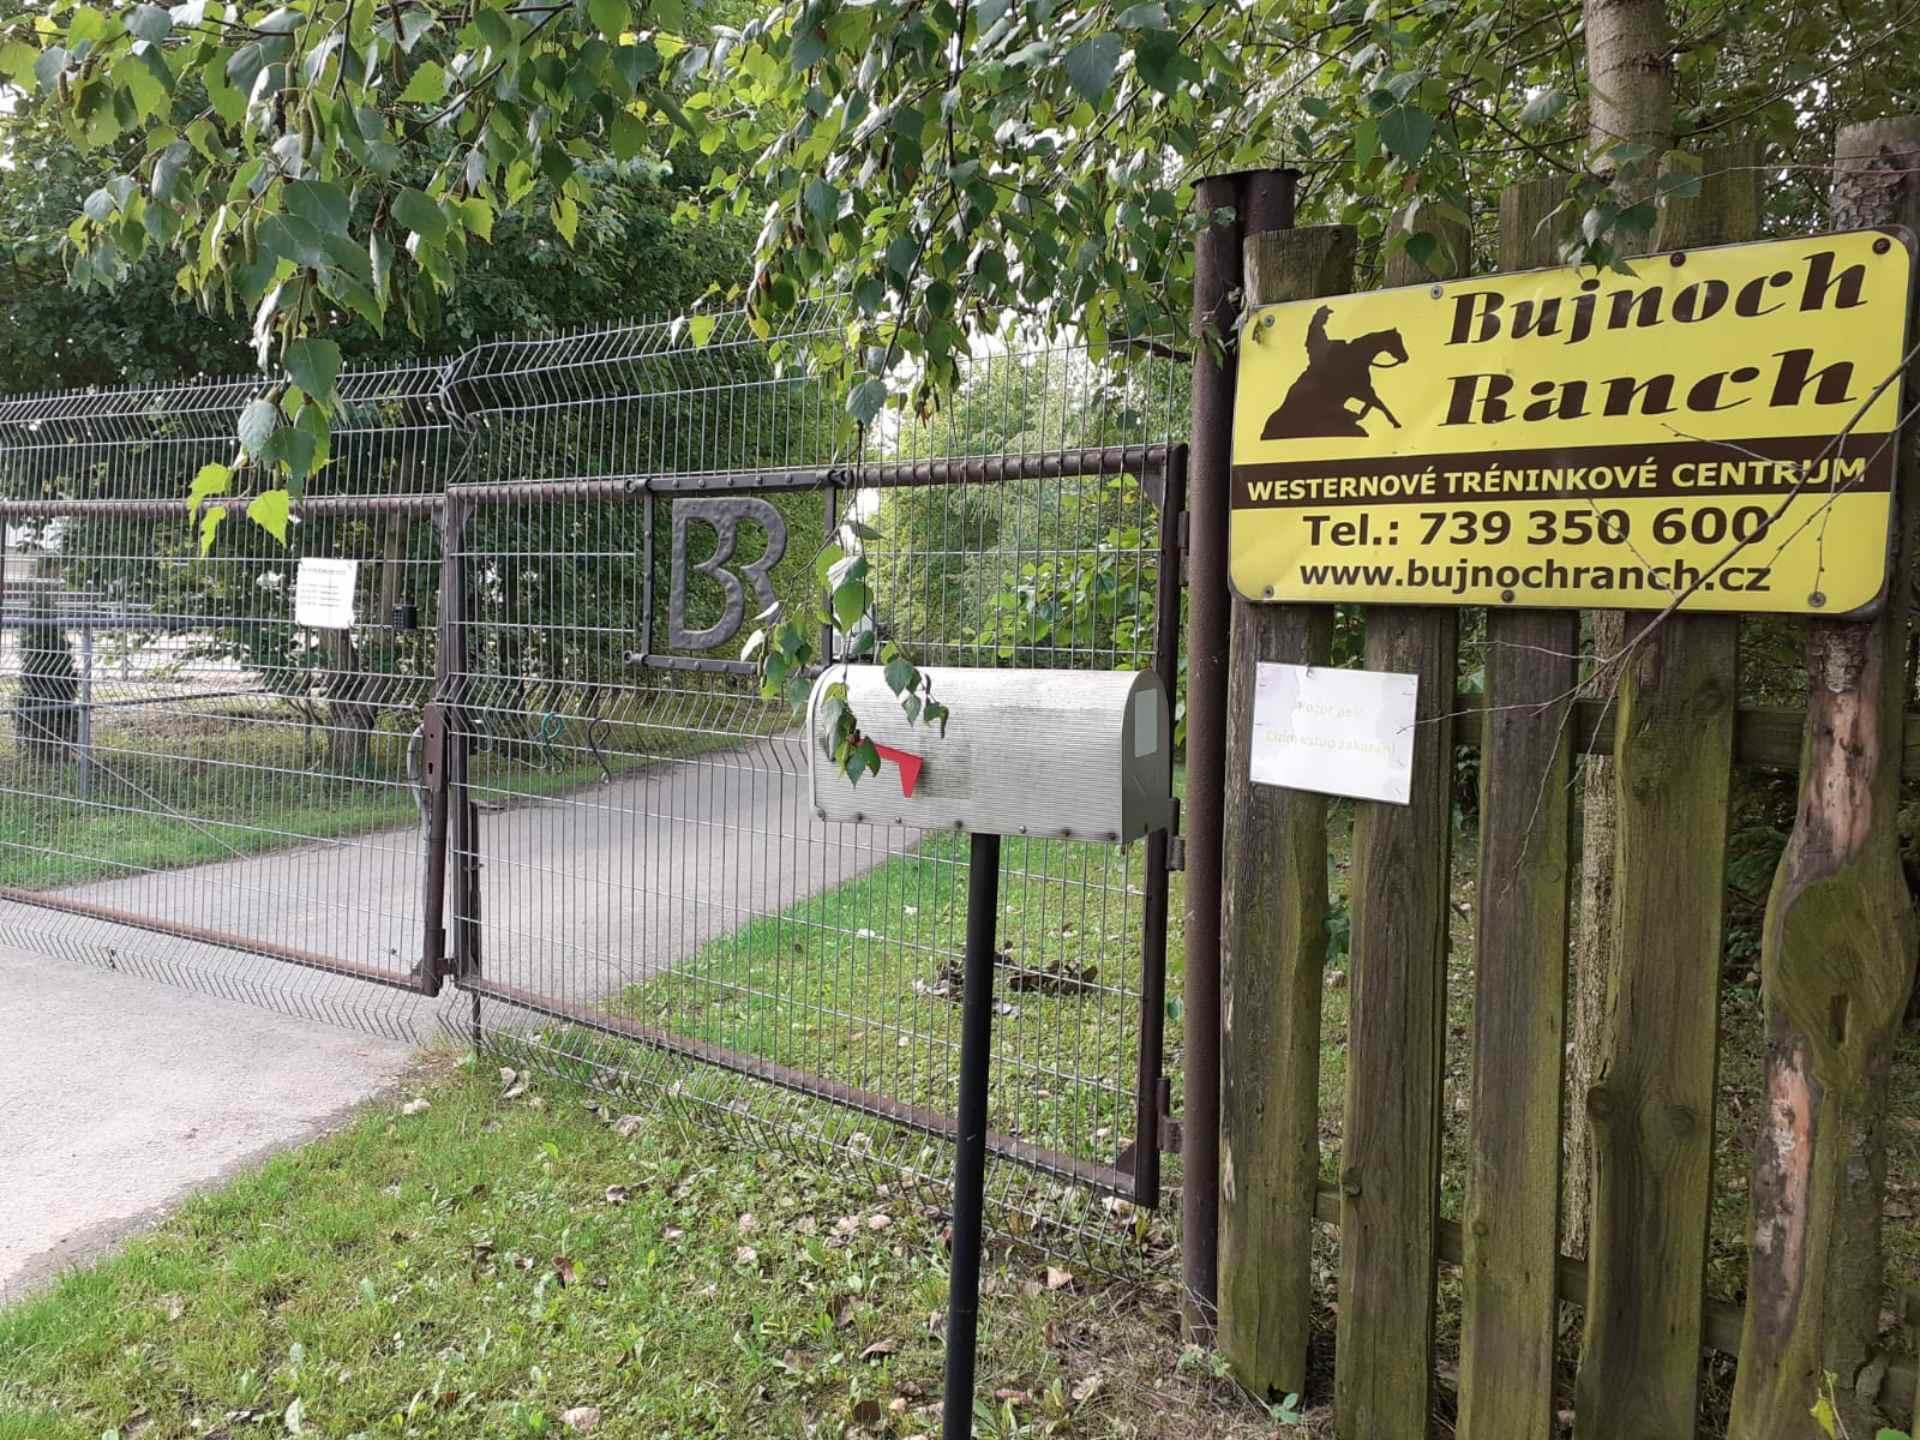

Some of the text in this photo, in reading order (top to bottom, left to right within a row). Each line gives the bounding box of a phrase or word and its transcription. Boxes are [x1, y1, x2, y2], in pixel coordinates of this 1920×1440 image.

[1444, 251, 1868, 346] Bujnoch
[1438, 348, 1857, 427] Ranch
[1247, 456, 1867, 501] WESTERNOVÉ TRÉNINKOVÉ CENTRUM
[1302, 506, 1769, 546] Tel.: 739 350 600
[1300, 558, 1771, 594] www.bujnochranch.cz
